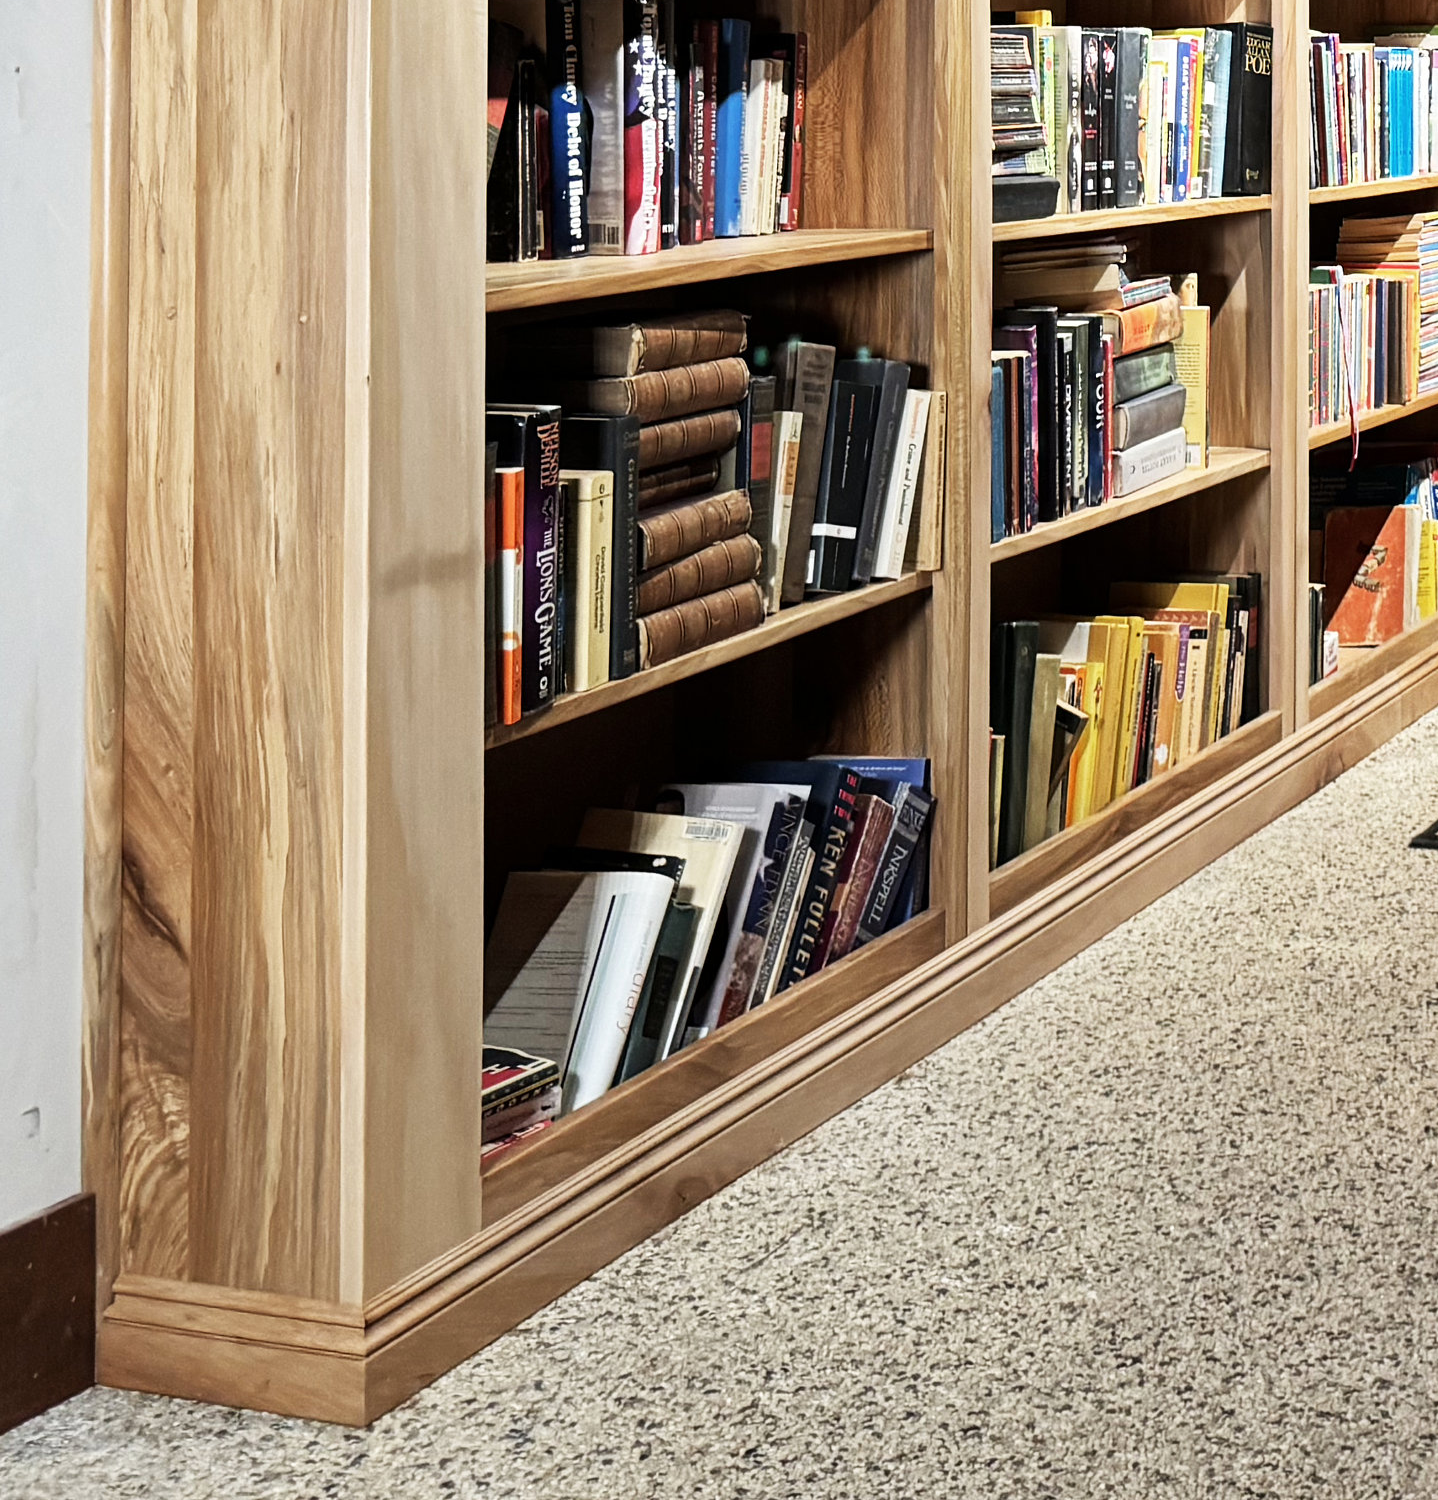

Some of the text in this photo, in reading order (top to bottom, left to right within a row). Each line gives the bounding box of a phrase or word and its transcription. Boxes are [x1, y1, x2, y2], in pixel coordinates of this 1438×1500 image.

[561, 2, 578, 105] Tom Clancy
[639, 3, 658, 119] Tom Clancy
[1245, 53, 1271, 76] POE
[1246, 36, 1271, 51] EDGAR
[796, 44, 806, 109] POPE JOAN
[1180, 56, 1191, 126] DEAR EDWARD
[664, 102, 676, 151] Clancy
[696, 91, 705, 193] ARTEMIS FOWL
[567, 112, 583, 239] Debt of Honor
[537, 425, 553, 489] DEMILLE
[547, 420, 560, 486] NELSON
[907, 443, 917, 465] Crime
[1064, 384, 1072, 489] DIVERGENT
[898, 483, 911, 525] Punishment
[904, 467, 915, 482] and
[544, 527, 553, 547] THE
[627, 459, 635, 629] GREAT EXPECTATIONS
[535, 602, 556, 671] GAME
[772, 803, 802, 860] VINCE
[820, 825, 847, 877] KEN
[754, 868, 783, 930] FLYNN
[868, 843, 908, 924] INKSPELL
[616, 973, 646, 1035] diary
